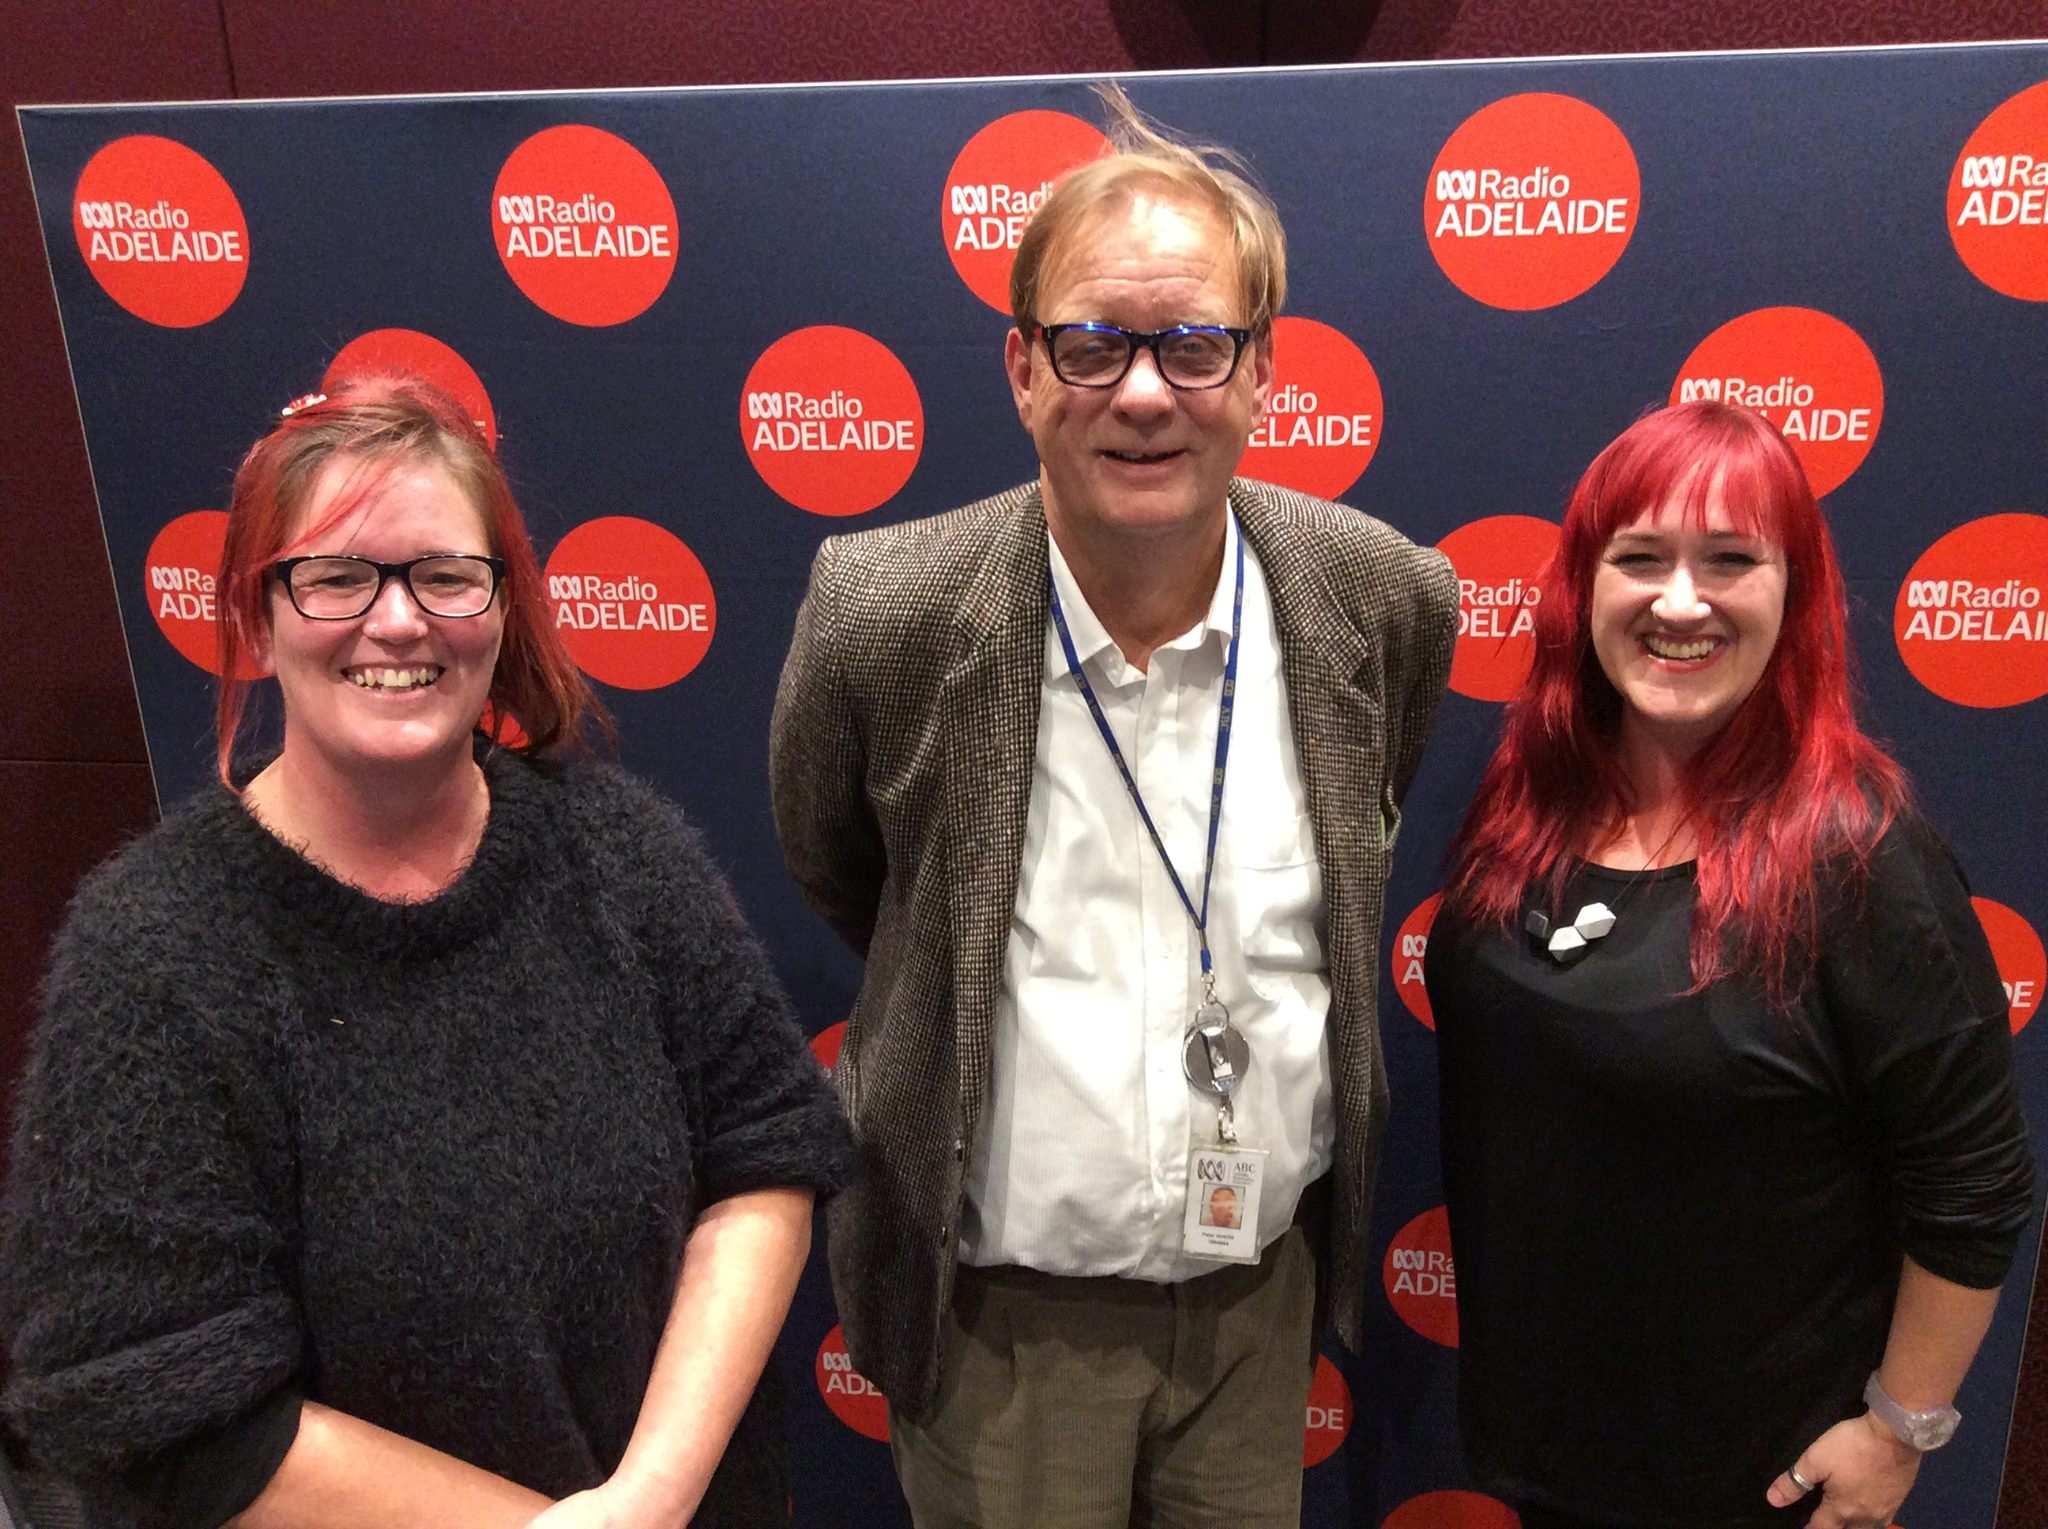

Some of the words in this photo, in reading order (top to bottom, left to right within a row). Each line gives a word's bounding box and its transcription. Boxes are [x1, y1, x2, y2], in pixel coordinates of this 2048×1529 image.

[991, 181, 1054, 215] Radi
[1480, 166, 1570, 200] Radio
[116, 200, 190, 230] Radio
[536, 194, 616, 224] Radio
[1435, 198, 1629, 237] ADELAIDE
[90, 230, 243, 262] ADELAIDE
[506, 225, 672, 258] ADELAIDE
[784, 390, 863, 419] Radio
[1265, 384, 1318, 414] dio
[1723, 376, 1814, 407] Radio
[753, 419, 915, 451] ADELAIDE
[1247, 414, 1372, 447] ELAIDE
[1782, 408, 1871, 442] AIDE
[583, 575, 658, 601] Radio
[1458, 578, 1542, 606] Radio
[1950, 579, 2040, 608] Radio
[555, 602, 709, 632] ADELAIDE
[1903, 610, 2048, 641] ADELAI
